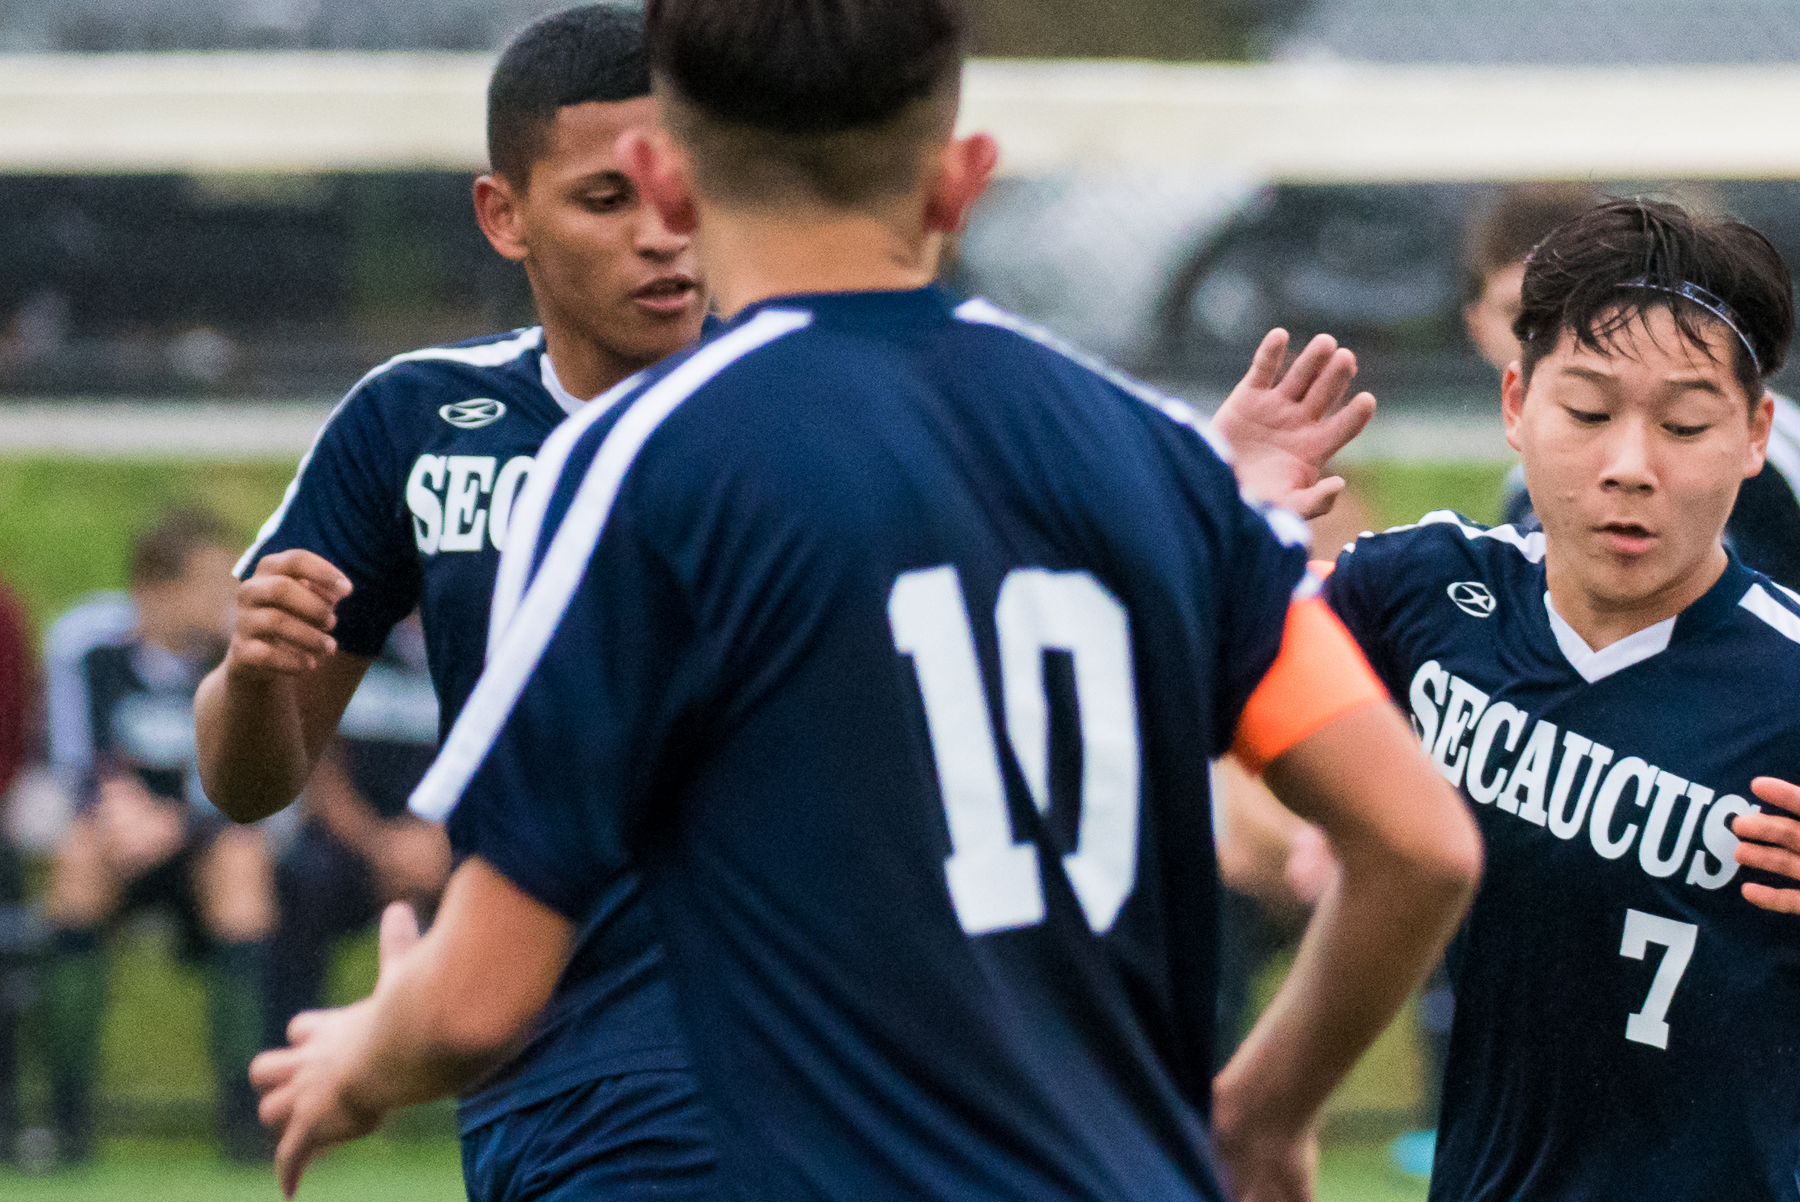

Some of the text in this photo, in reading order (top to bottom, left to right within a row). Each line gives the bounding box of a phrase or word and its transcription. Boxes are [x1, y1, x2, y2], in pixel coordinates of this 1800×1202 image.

[887, 563, 1143, 936] 10
[1409, 660, 1762, 891] SECAUCUS
[1619, 908, 1699, 1050] 7
